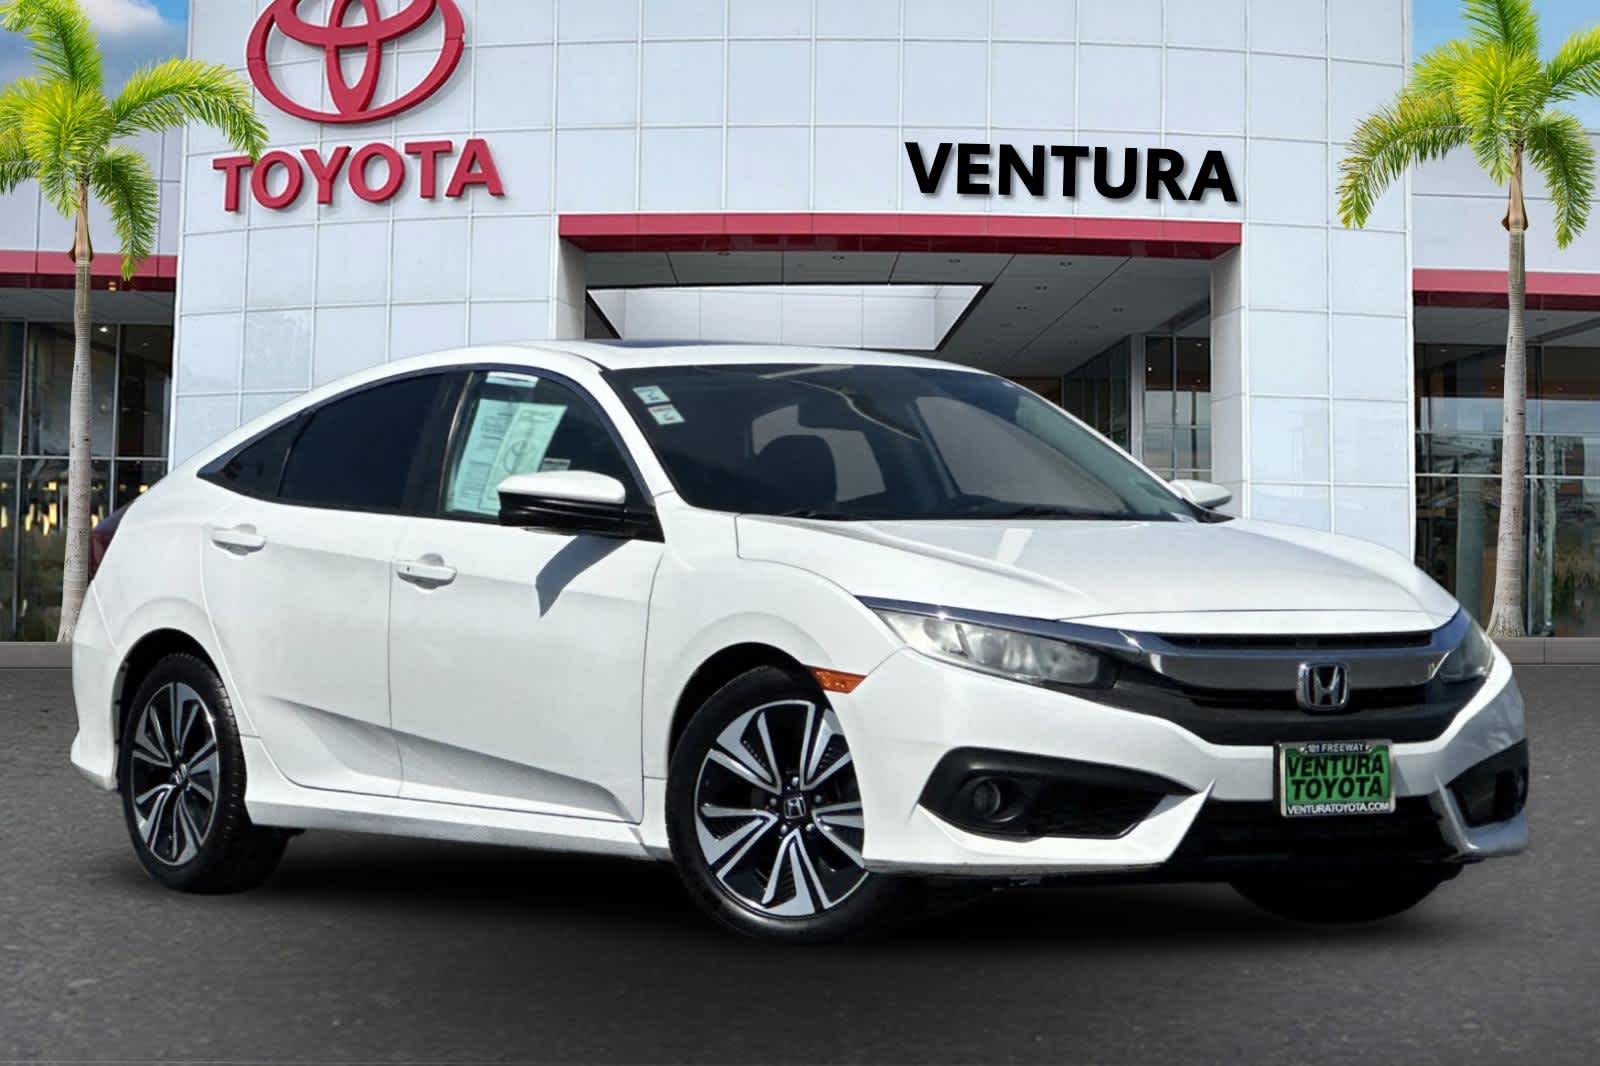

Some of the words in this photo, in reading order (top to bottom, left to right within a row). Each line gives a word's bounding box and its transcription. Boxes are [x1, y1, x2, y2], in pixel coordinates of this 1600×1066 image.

[212, 138, 505, 213] TOYOTA
[904, 141, 1240, 203] VENTURA
[1287, 754, 1384, 776] VENTURA
[1292, 776, 1383, 800] TOYOTA
[1287, 802, 1390, 814] VENTURATOYOTA.COM
